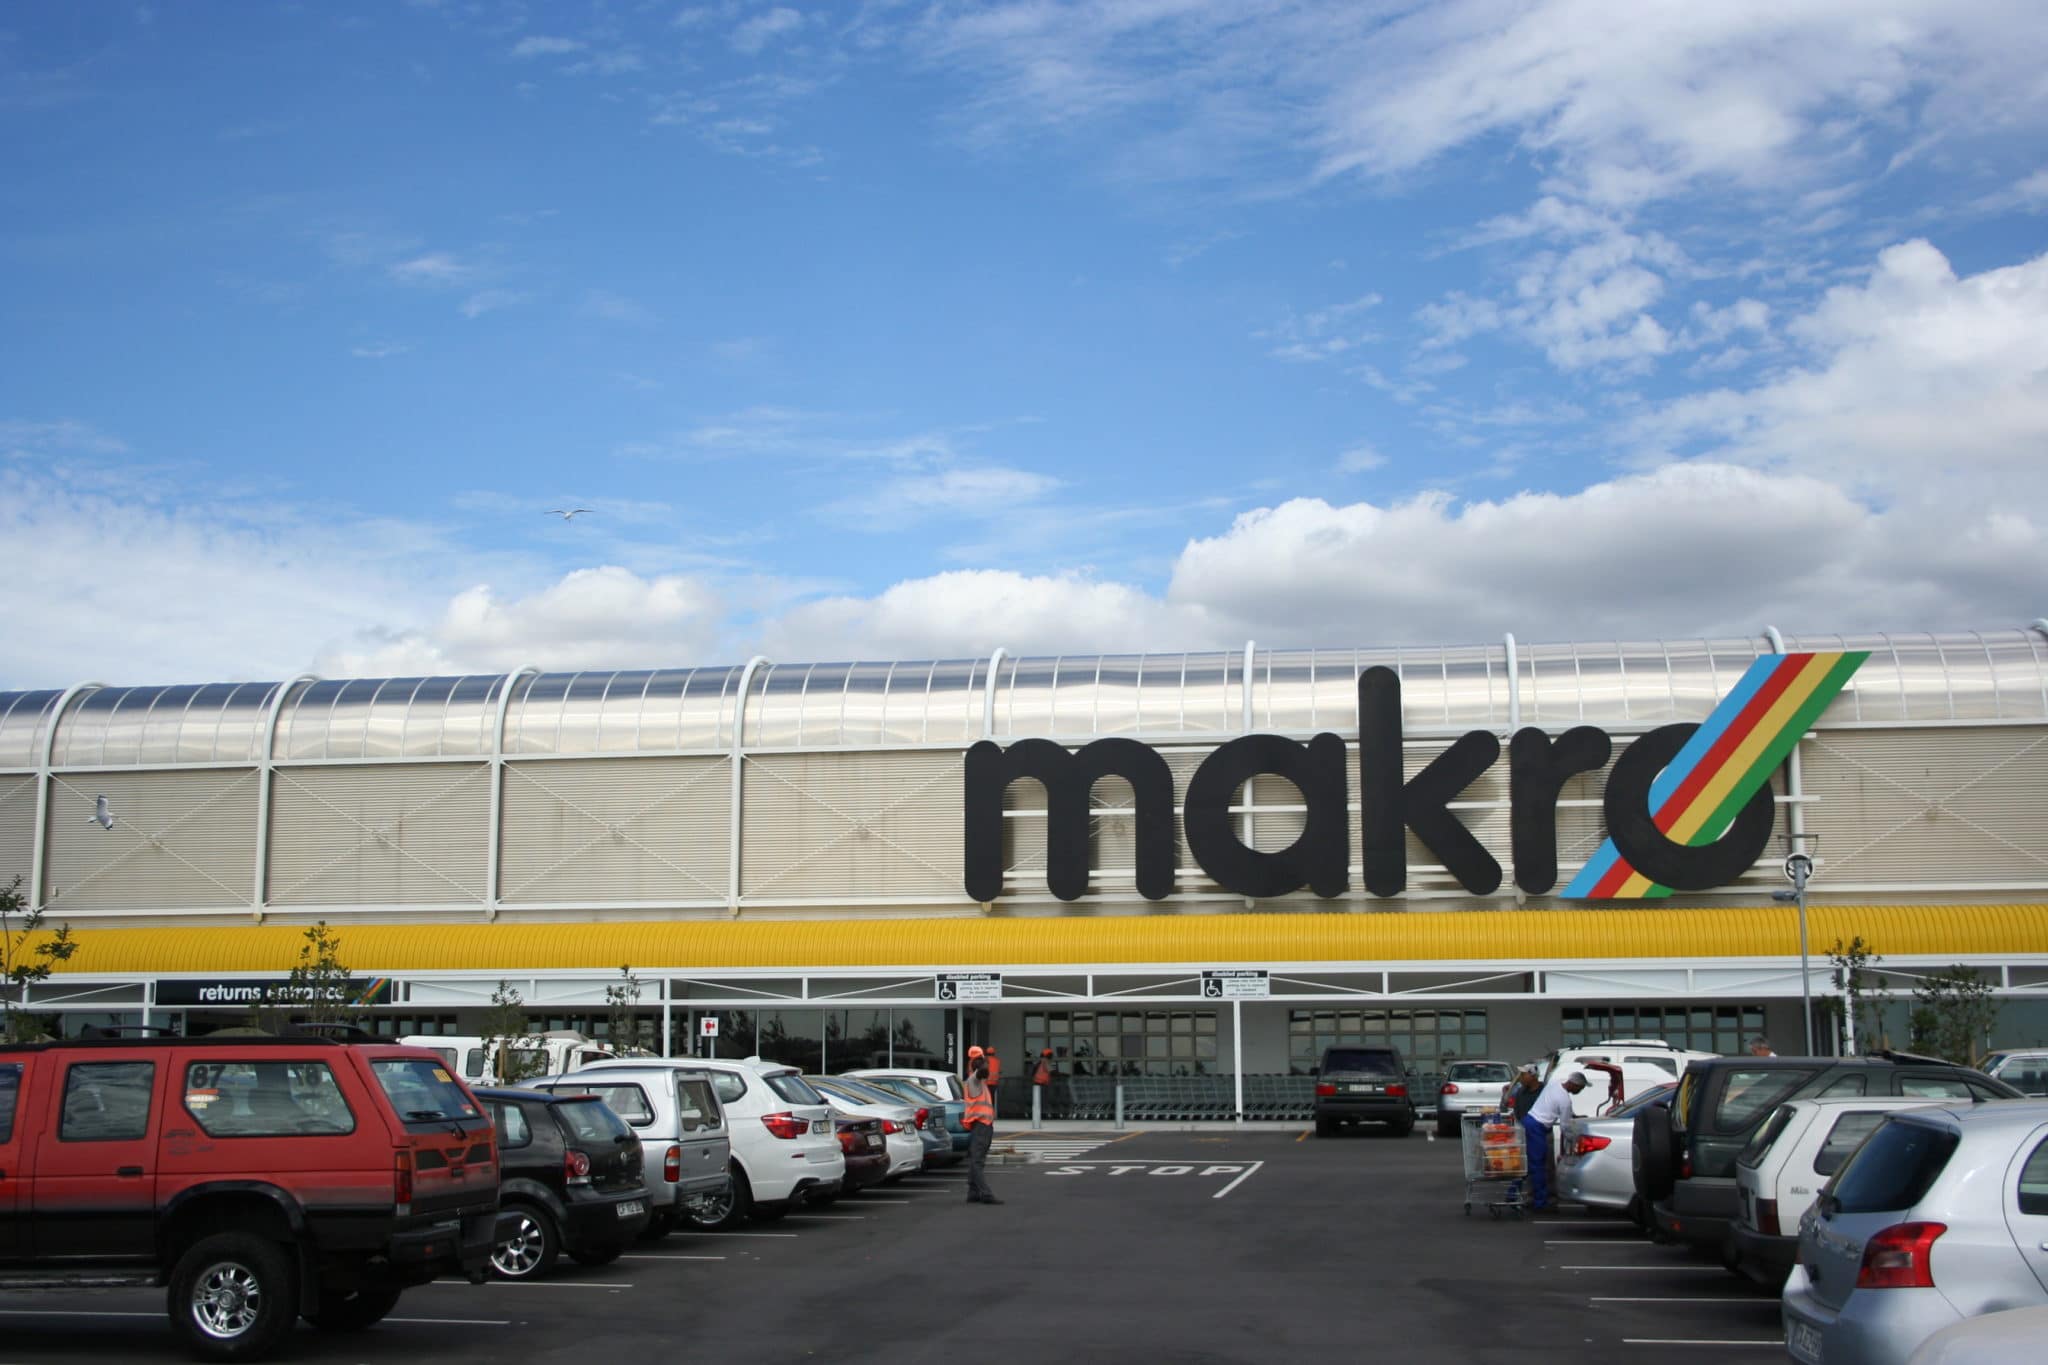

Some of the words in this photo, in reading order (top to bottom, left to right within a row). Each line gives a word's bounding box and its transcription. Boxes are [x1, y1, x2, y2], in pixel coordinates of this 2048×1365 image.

[964, 665, 1775, 903] makro
[200, 984, 261, 1000] returns
[191, 1065, 226, 1089] 87
[1044, 1165, 1245, 1176] STOP
